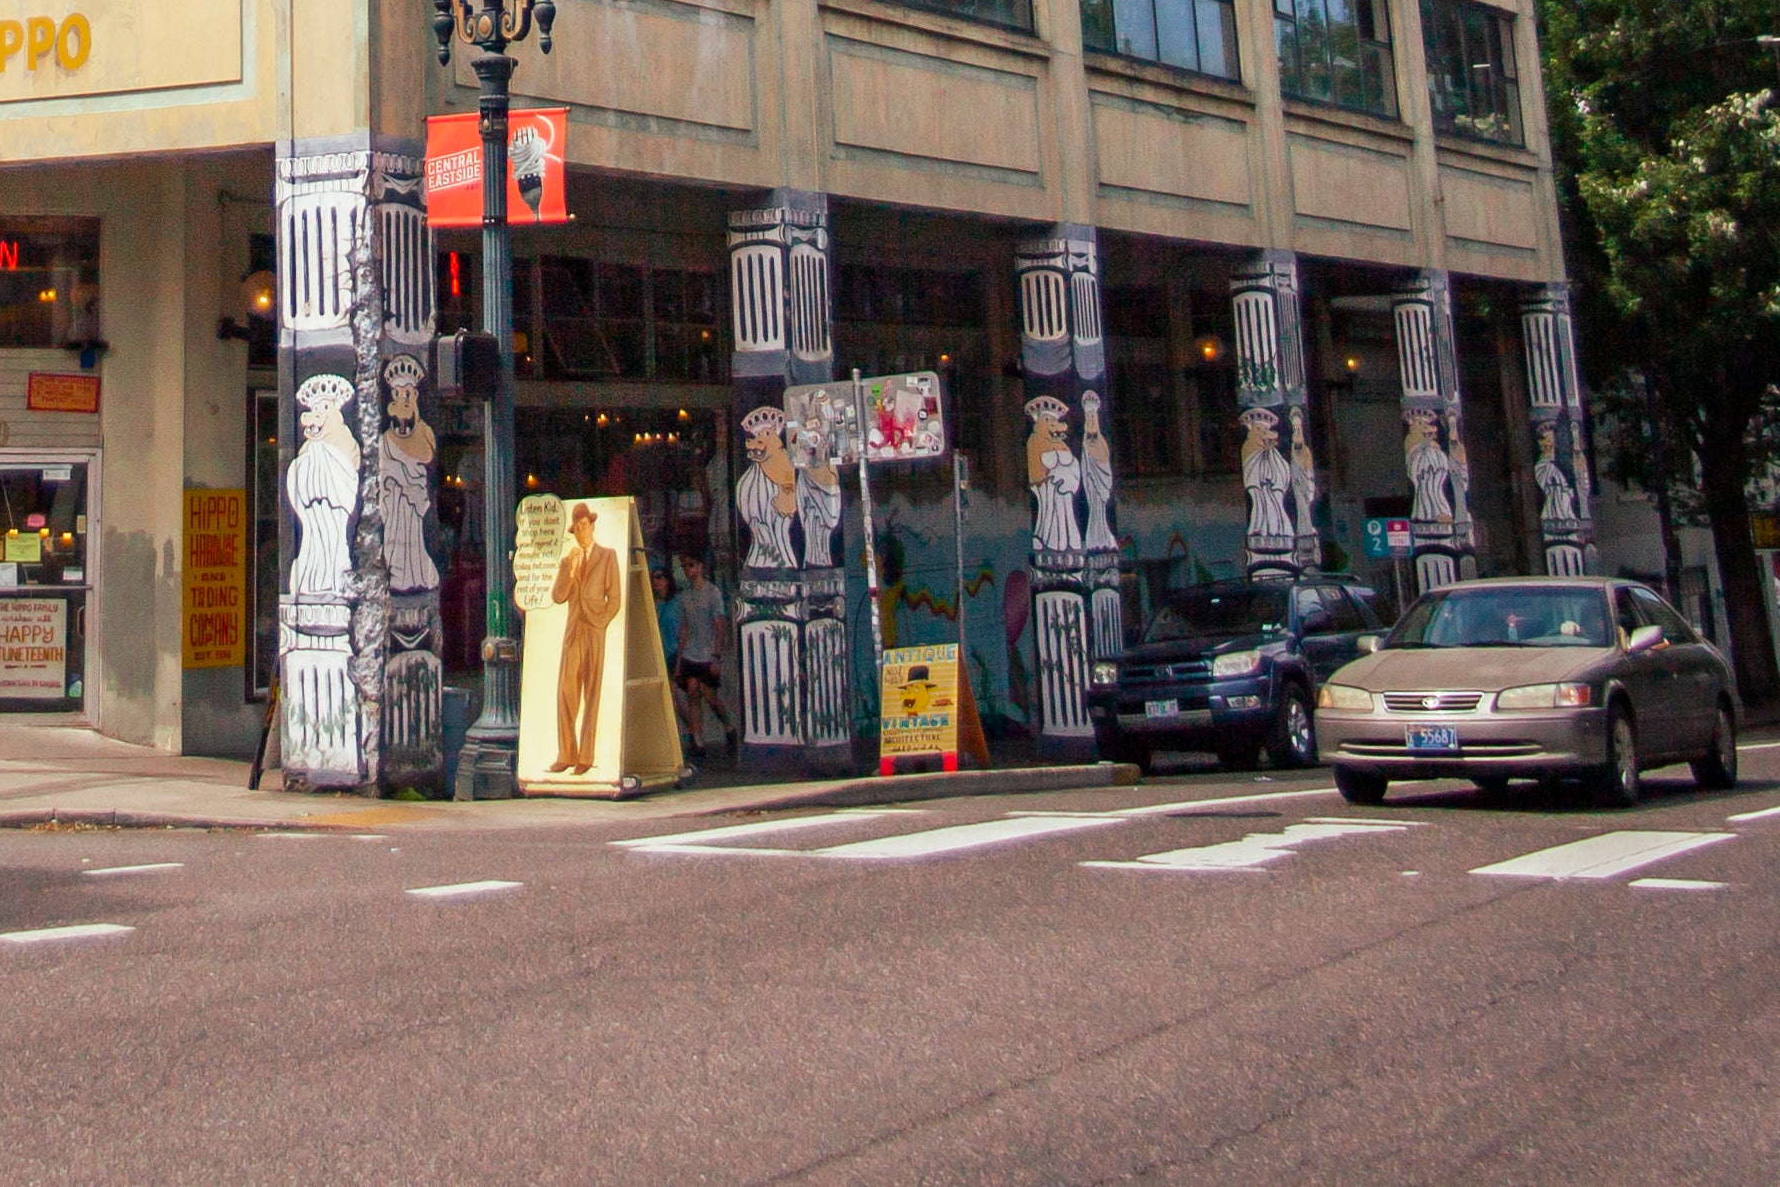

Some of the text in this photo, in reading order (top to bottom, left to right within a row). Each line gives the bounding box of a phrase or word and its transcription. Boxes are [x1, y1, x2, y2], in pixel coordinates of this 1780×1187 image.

[428, 151, 481, 176] CENTRAL
[428, 166, 481, 189] EASTSIDE
[1372, 537, 1381, 551] 2
[542, 549, 553, 557] not
[531, 573, 540, 581] for
[542, 573, 553, 581] the
[11, 602, 32, 612] HIPPO
[34, 603, 59, 612] FAMILY
[883, 644, 958, 664] ANTIQUE
[882, 714, 949, 729] VINTAGE
